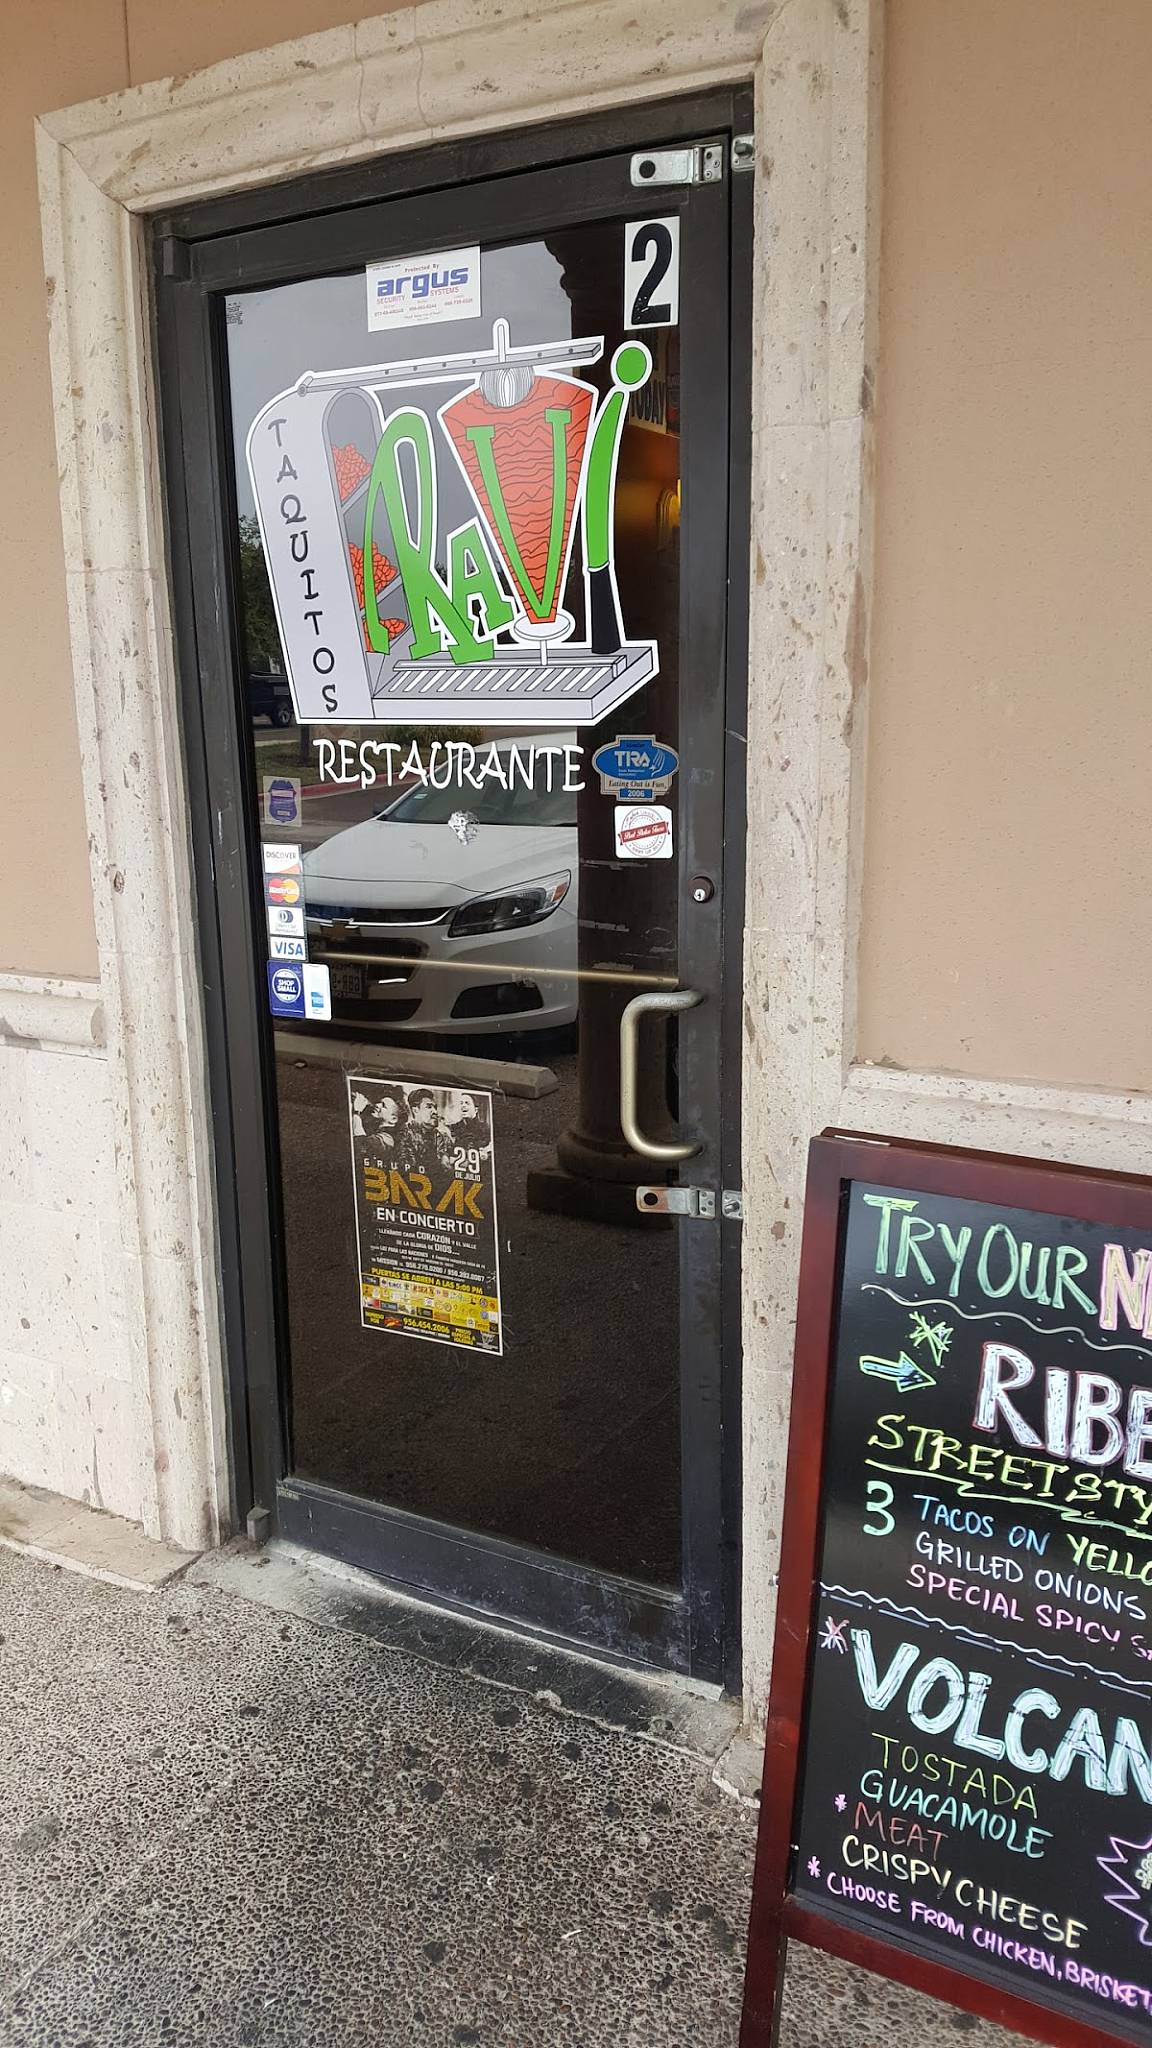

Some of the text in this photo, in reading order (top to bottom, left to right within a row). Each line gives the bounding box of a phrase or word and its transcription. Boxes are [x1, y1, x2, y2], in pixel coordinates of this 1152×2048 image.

[377, 267, 469, 299] argus
[404, 264, 431, 273] Protected
[630, 222, 673, 326] 2
[376, 286, 460, 305] SECURITY SYSTEMS
[267, 418, 339, 713] TAQUITOS
[312, 739, 586, 793] RESTAURANTE
[608, 780, 629, 789] Eating
[629, 780, 643, 788] Out
[627, 789, 645, 797] 2006
[265, 851, 297, 860] DISCOVER
[274, 942, 304, 956] VISA
[276, 985, 297, 993] SMALL
[277, 979, 295, 987] SHOP
[454, 1146, 481, 1174] 29
[463, 1173, 481, 1182] JULIO
[363, 1166, 485, 1219] BARAK
[376, 1207, 475, 1236] EN CONCIERTO
[371, 1267, 401, 1279] PUERTAS
[401, 1272, 411, 1281] SE
[442, 1280, 455, 1289] LAS
[863, 1194, 1152, 1339] TRY OUR N
[867, 1414, 1071, 1498] STREET
[863, 1480, 896, 1536] 3
[912, 1494, 995, 1538] TACOS
[1008, 1525, 1051, 1556] ON
[917, 1531, 1147, 1620] GRILLED ONIONS
[907, 1564, 1024, 1622] SPECIAL
[1036, 1604, 1121, 1643] SPICY
[871, 1732, 1039, 1819] TOSTADA
[854, 1801, 949, 1860] MEAT
[860, 1769, 1053, 1859] GUACAMOLE
[826, 1872, 901, 1914] CHOOSE
[910, 1903, 965, 1940] FROM
[842, 1834, 1088, 1950] CRISPY CHEESE
